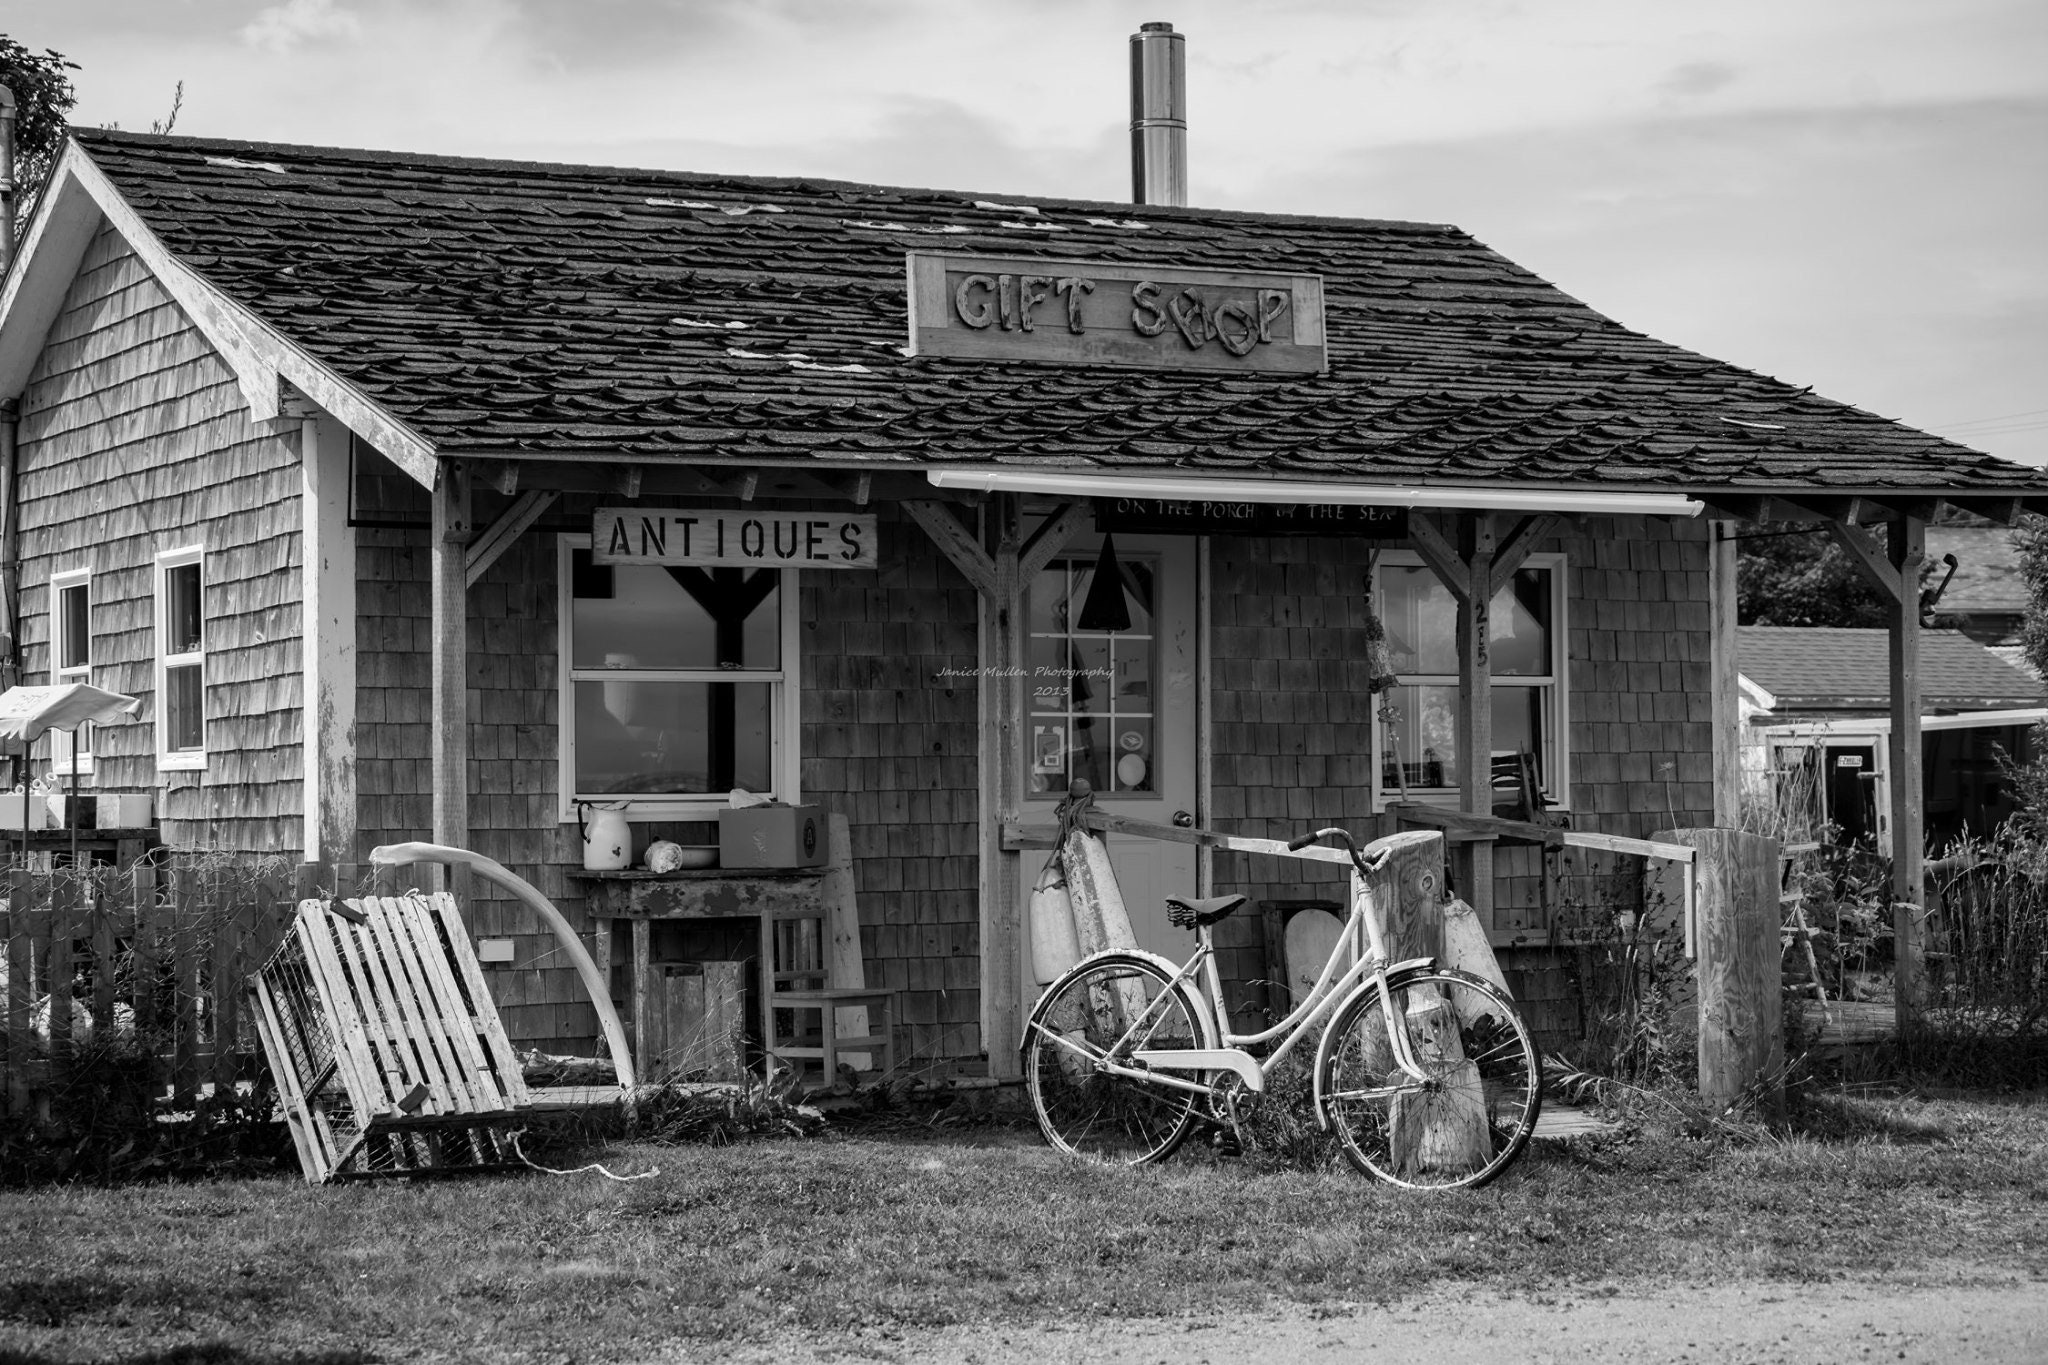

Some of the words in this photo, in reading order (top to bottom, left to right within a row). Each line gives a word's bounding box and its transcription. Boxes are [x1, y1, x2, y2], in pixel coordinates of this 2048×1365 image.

[956, 274, 1096, 336] GIFT
[1131, 280, 1289, 357] SHOP
[1117, 498, 1146, 514] ON
[1156, 500, 1192, 516] THE
[1202, 501, 1254, 519] PORCH
[1306, 503, 1345, 520] THE
[608, 516, 862, 561] ANTIQUES
